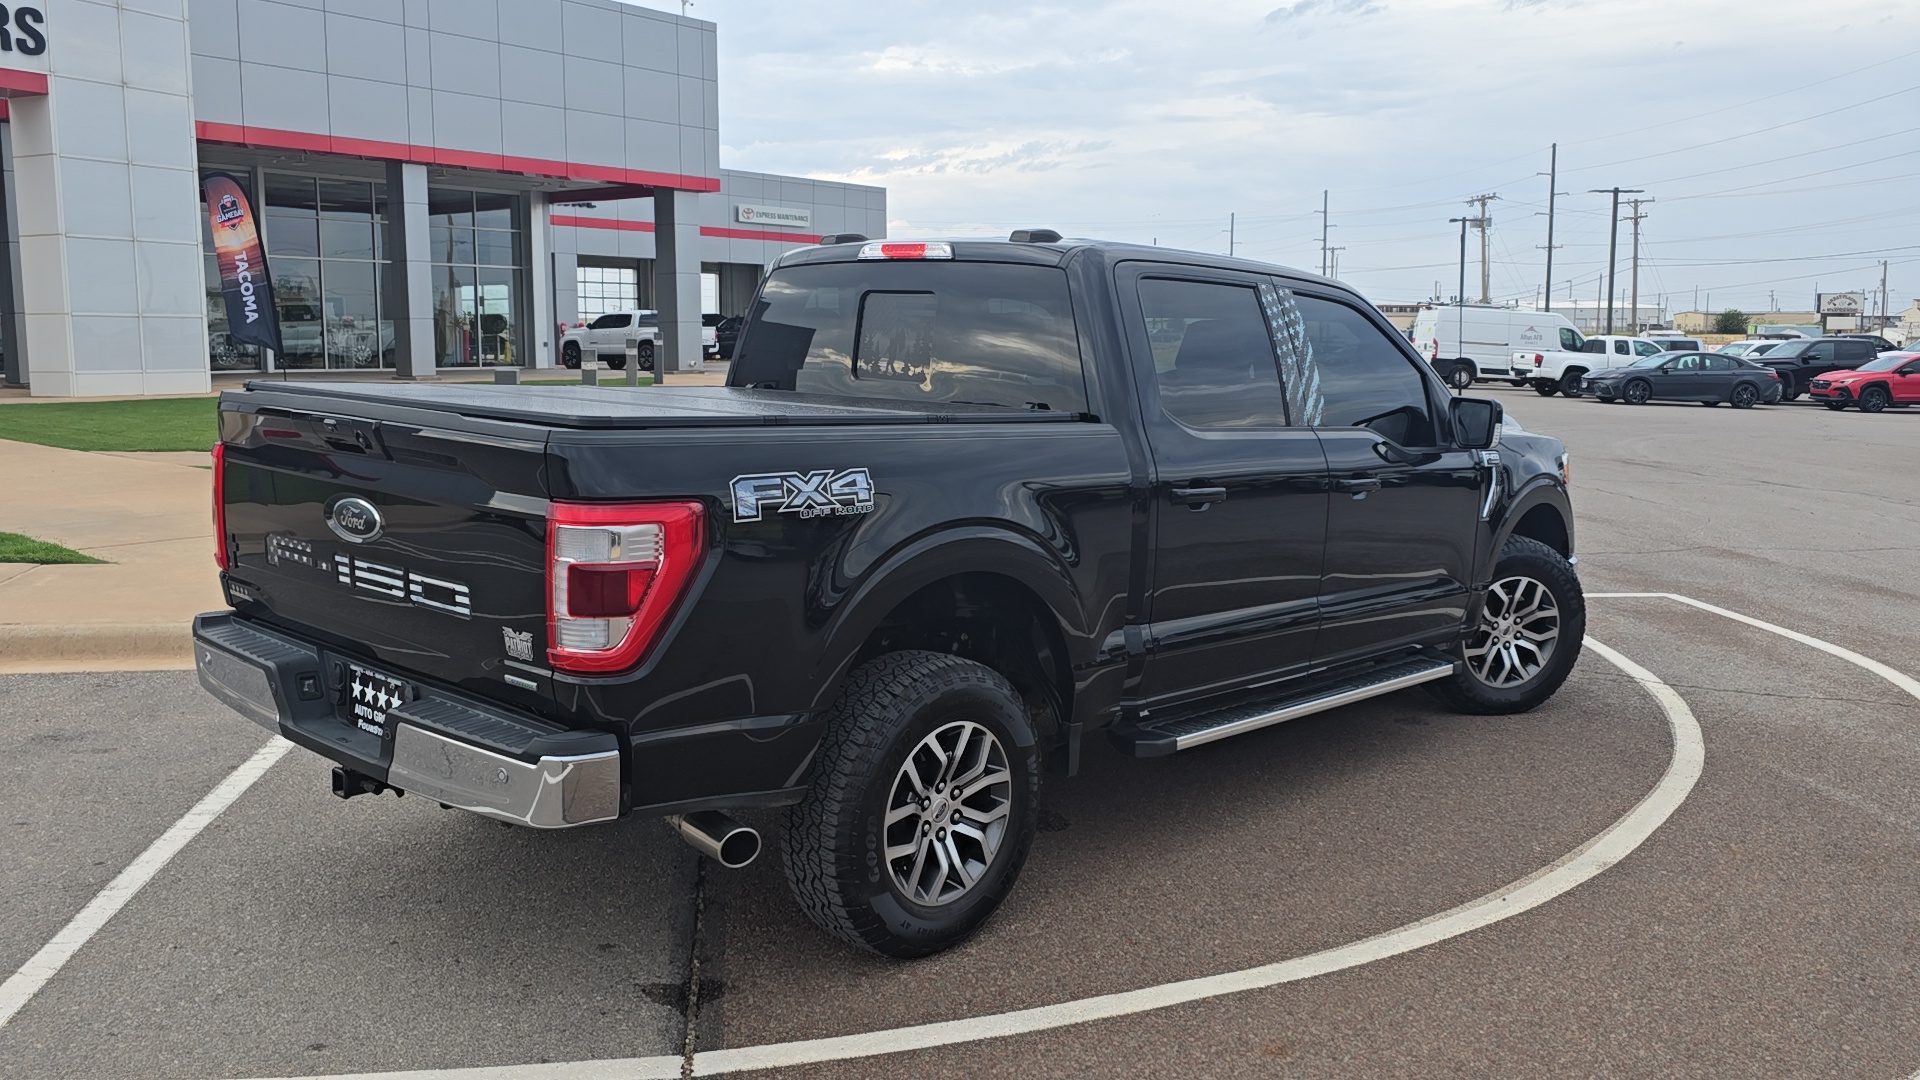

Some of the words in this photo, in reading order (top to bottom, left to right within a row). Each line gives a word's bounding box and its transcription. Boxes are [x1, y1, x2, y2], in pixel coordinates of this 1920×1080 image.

[756, 211, 777, 220] EXPRESS
[777, 213, 808, 222] MAINTENANCE
[234, 250, 259, 324] TACOMA
[729, 468, 875, 523] FX4
[340, 504, 367, 531] Ford
[800, 508, 831, 519] OFF
[834, 504, 875, 516] ROAD
[355, 704, 372, 719] AUTO
